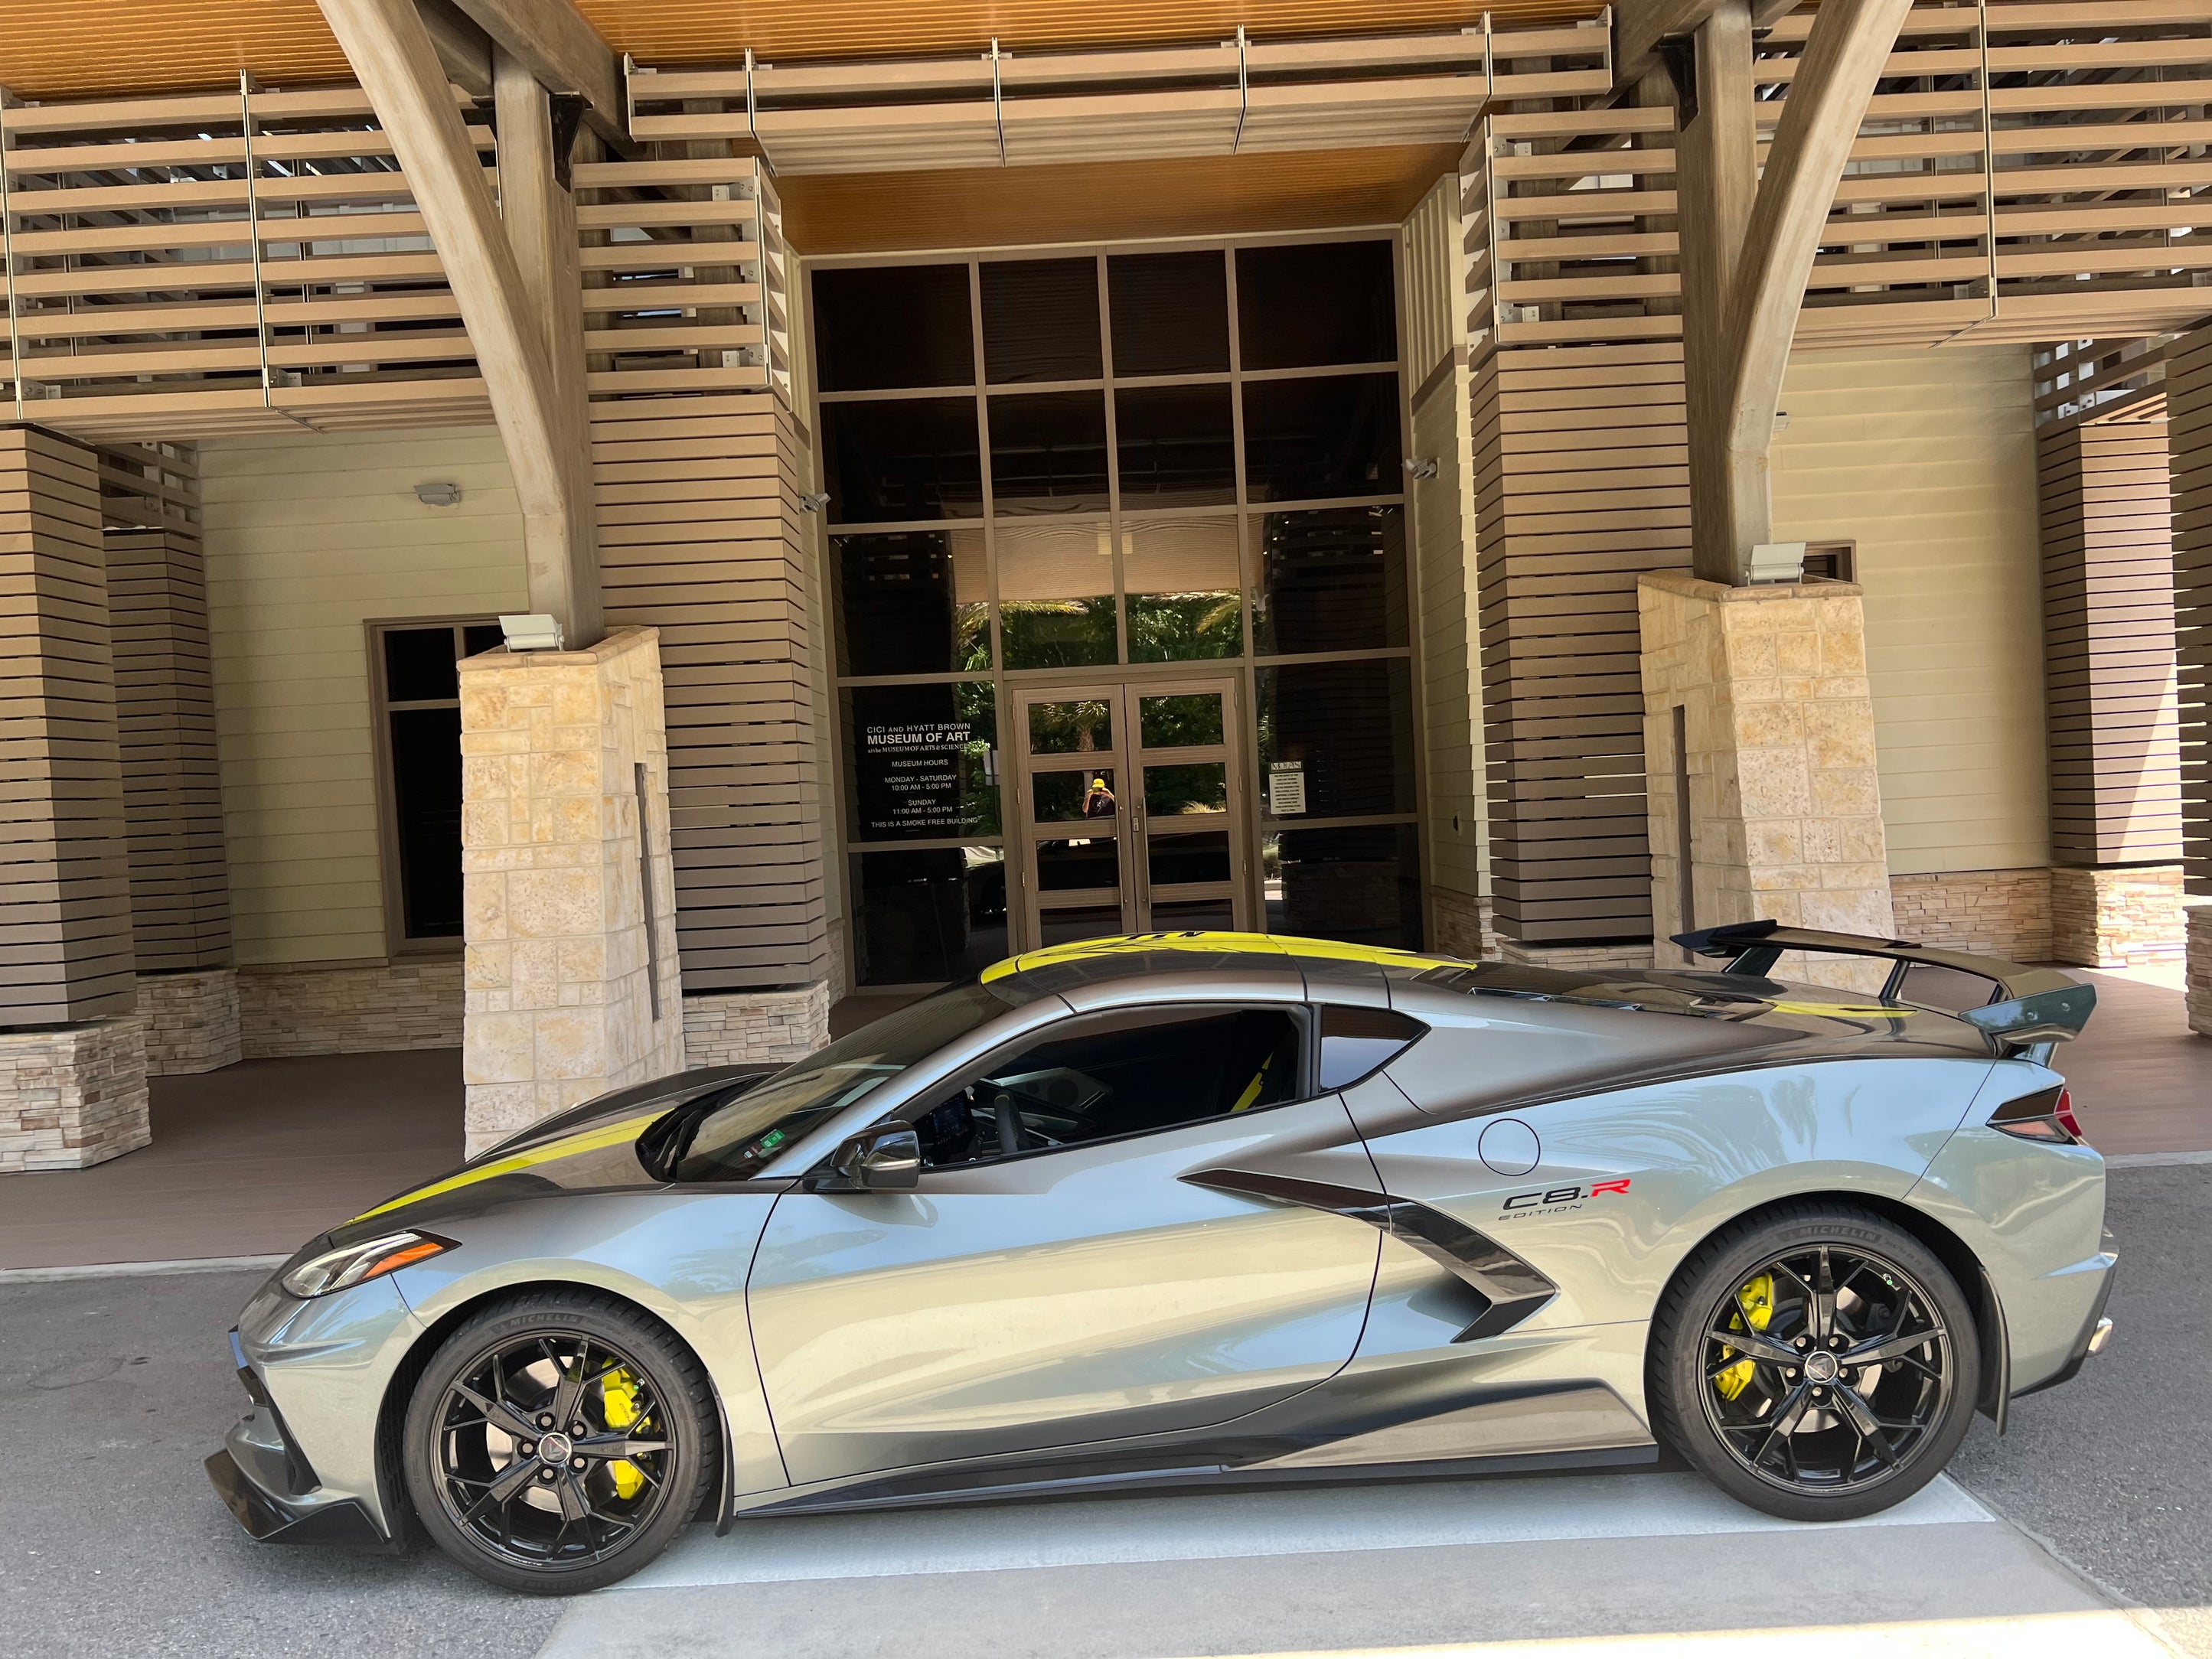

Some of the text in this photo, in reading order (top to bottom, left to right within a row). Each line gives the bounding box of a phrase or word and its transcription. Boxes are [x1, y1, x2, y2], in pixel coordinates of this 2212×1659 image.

[907, 724, 935, 732] HYATT
[938, 722, 971, 731] BROWN
[867, 731, 971, 745] MUSEUM OF ART
[919, 774, 957, 782] SATURDAY
[1502, 1178, 1631, 1210] C8.R
[1498, 1204, 1582, 1221] EDITION
[1800, 1227, 1876, 1240] MICHELIN
[510, 1314, 579, 1326] MICHELIN
